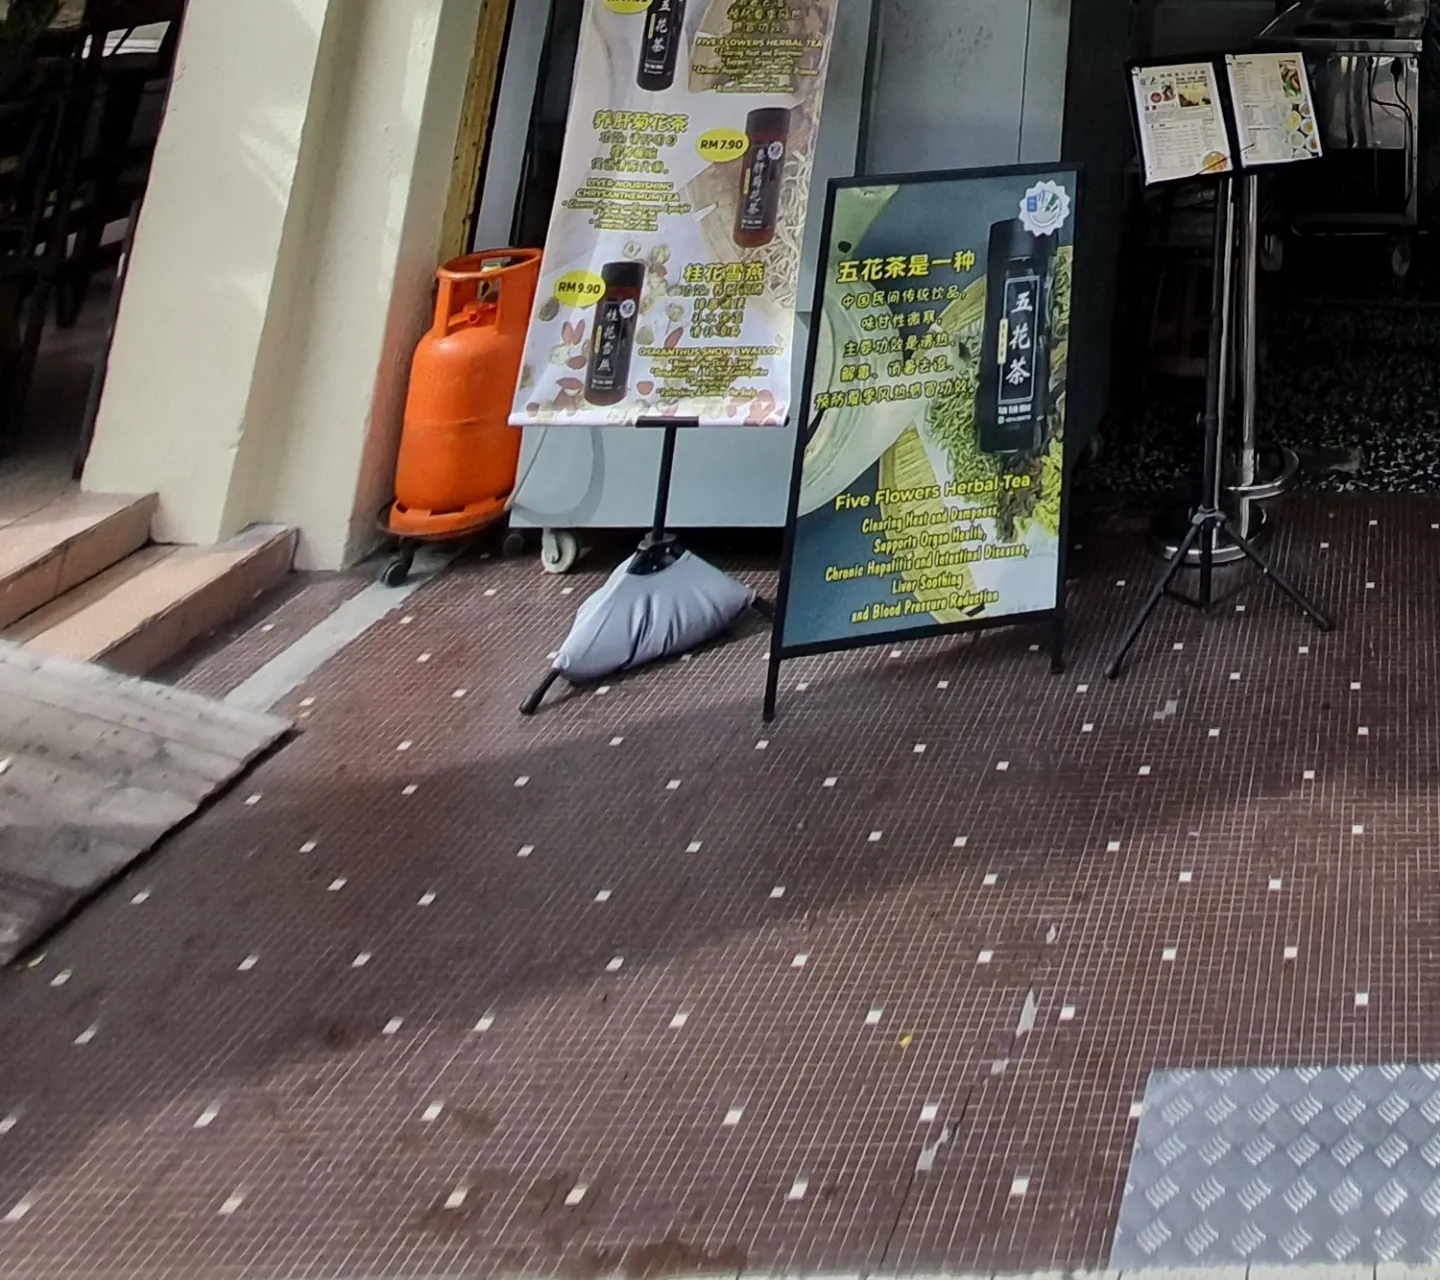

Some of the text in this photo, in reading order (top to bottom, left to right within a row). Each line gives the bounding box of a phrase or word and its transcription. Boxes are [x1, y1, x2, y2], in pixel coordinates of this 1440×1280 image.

[593, 109, 690, 133] 养肝菊花茶
[683, 262, 765, 283] 桂花雪燕
[835, 249, 977, 284] 五花茶是一种
[1004, 290, 1034, 386] 五花茶
[834, 473, 1031, 512] Five Flowers Herbal Tea
[861, 516, 904, 535] Clearing
[905, 511, 929, 529] Heat
[930, 508, 947, 524] and
[873, 536, 917, 556] Supports
[919, 531, 950, 549] Organ
[824, 566, 864, 583] Chronic
[914, 554, 932, 570] and
[891, 572, 964, 595] Liver Soothing
[850, 589, 1000, 624] and Blood Pressure Reduction
